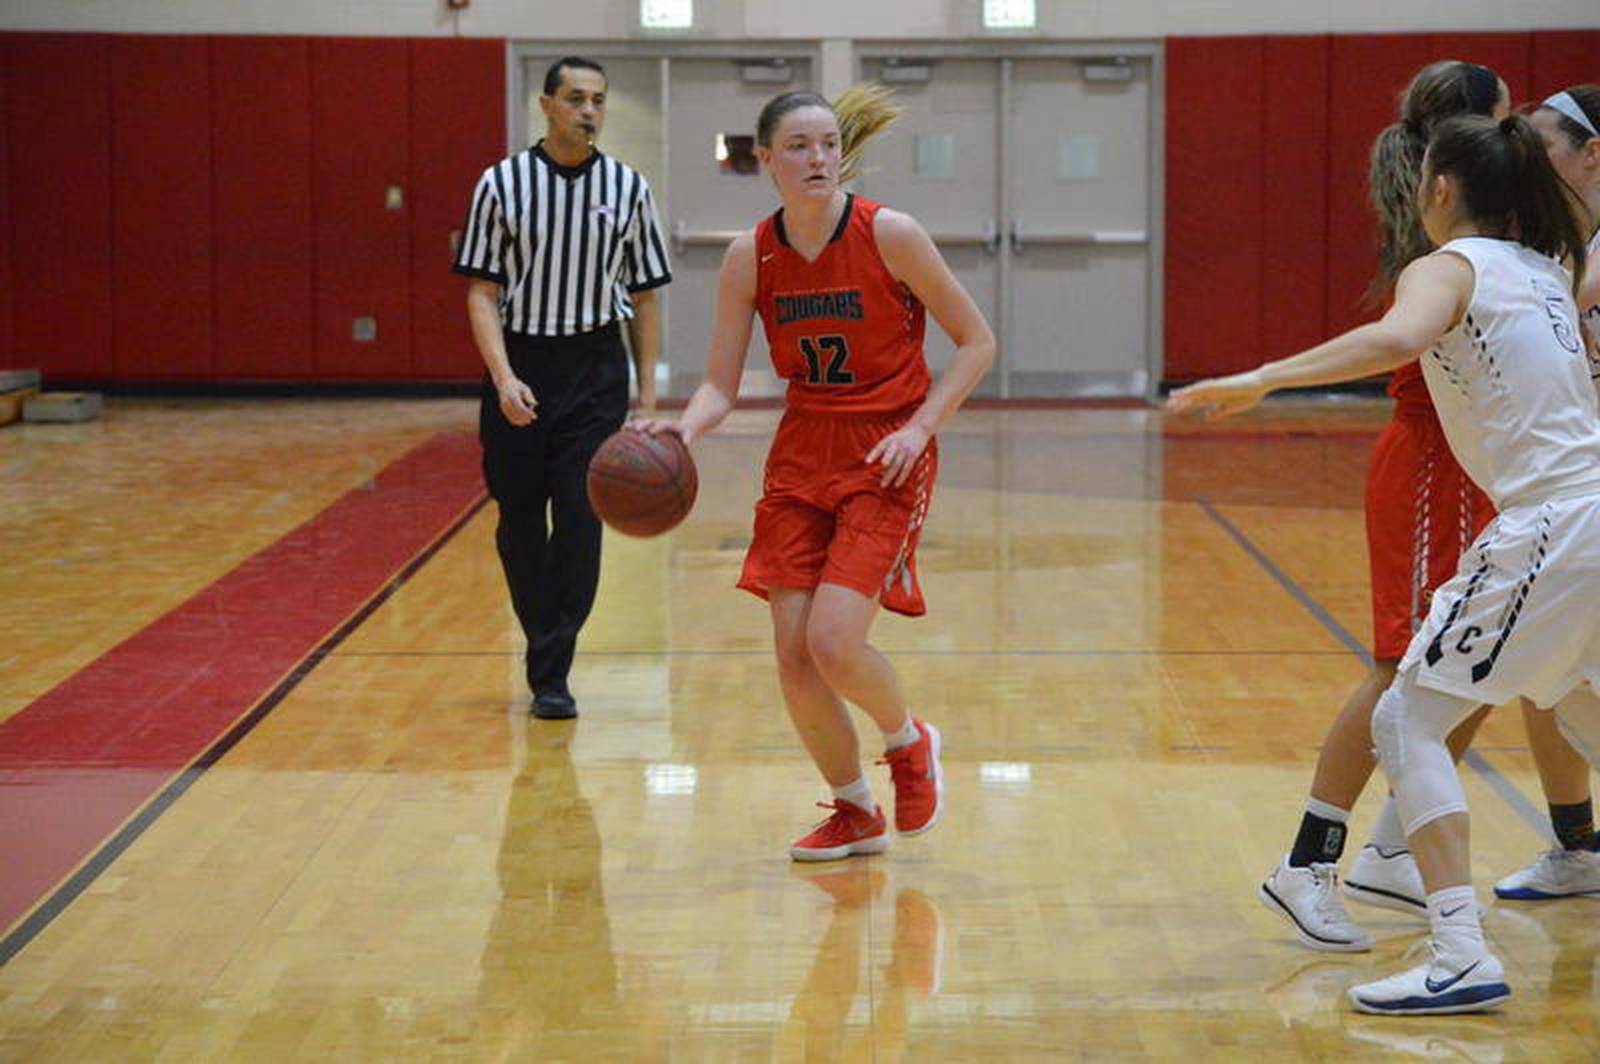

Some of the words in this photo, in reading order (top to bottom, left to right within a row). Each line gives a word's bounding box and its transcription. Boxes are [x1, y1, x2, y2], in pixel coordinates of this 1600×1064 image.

[774, 290, 864, 325] COUGARS
[800, 334, 855, 384] 12
[1456, 626, 1482, 654] C
